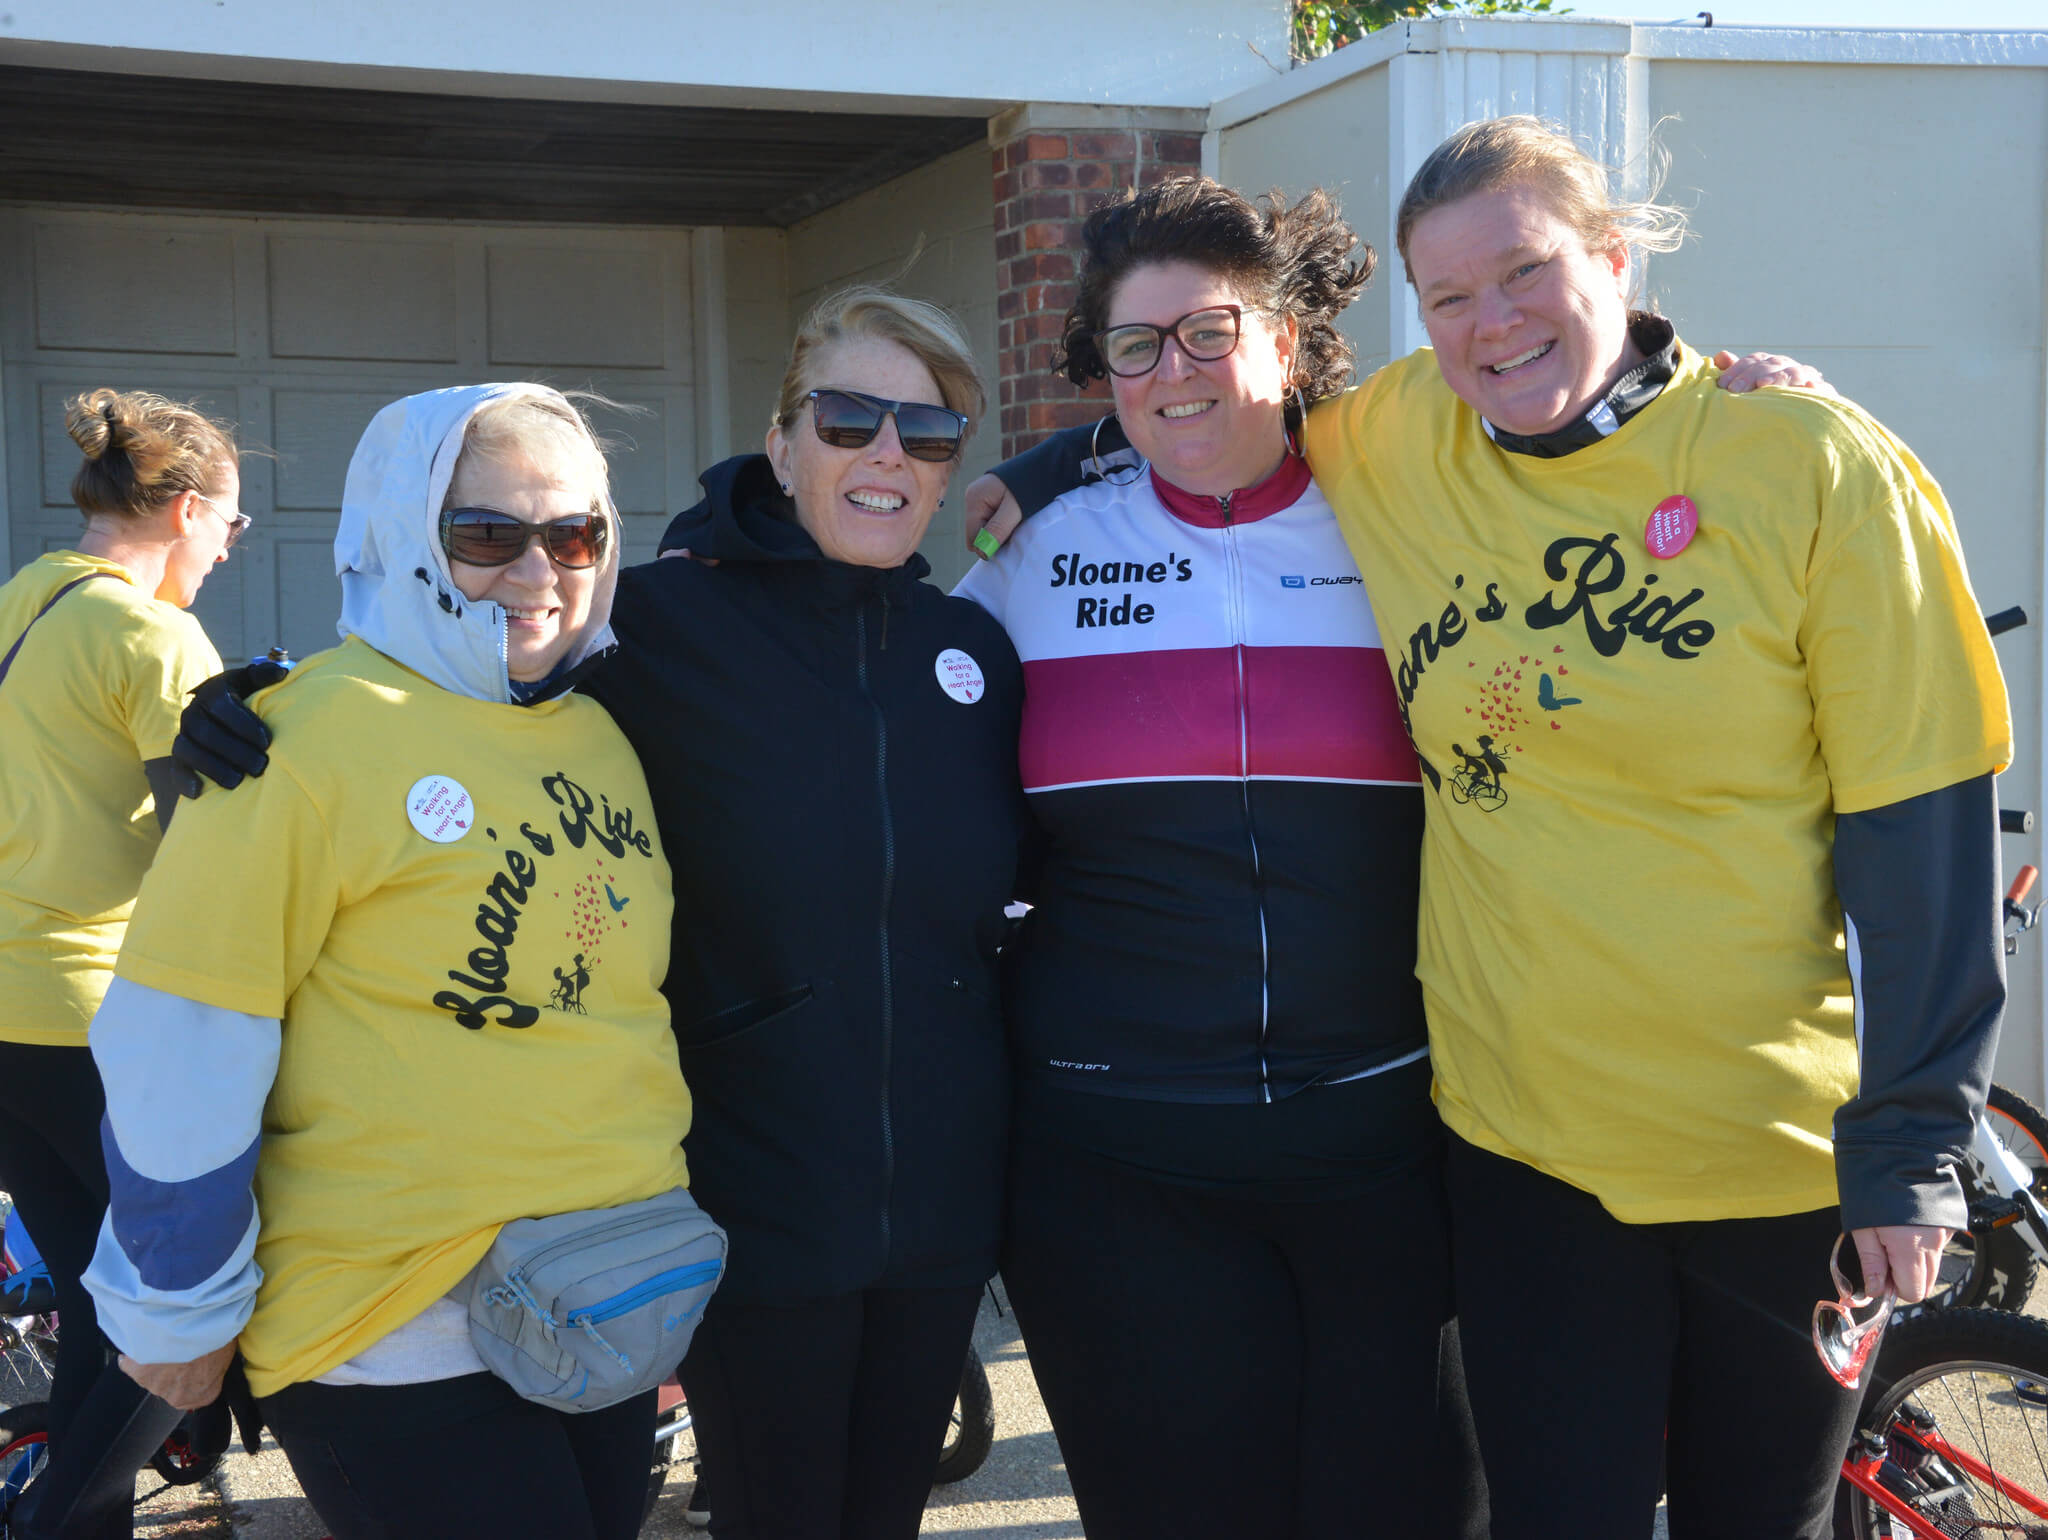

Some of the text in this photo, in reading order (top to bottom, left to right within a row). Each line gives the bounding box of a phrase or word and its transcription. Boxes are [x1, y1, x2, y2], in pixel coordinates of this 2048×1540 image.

[1653, 510, 1666, 553] Warrior!
[1663, 512, 1673, 542] Heart
[1672, 508, 1681, 536] I'm a
[1050, 552, 1192, 587] Sloane's
[1076, 594, 1155, 628] Ride
[1525, 533, 1715, 659] Ride
[946, 663, 973, 672] Walking
[947, 681, 966, 689] Heart
[421, 786, 449, 816] Walking
[434, 806, 446, 817] for
[434, 793, 468, 837] Heart Angel
[433, 771, 653, 1030] Sloane's Ride
